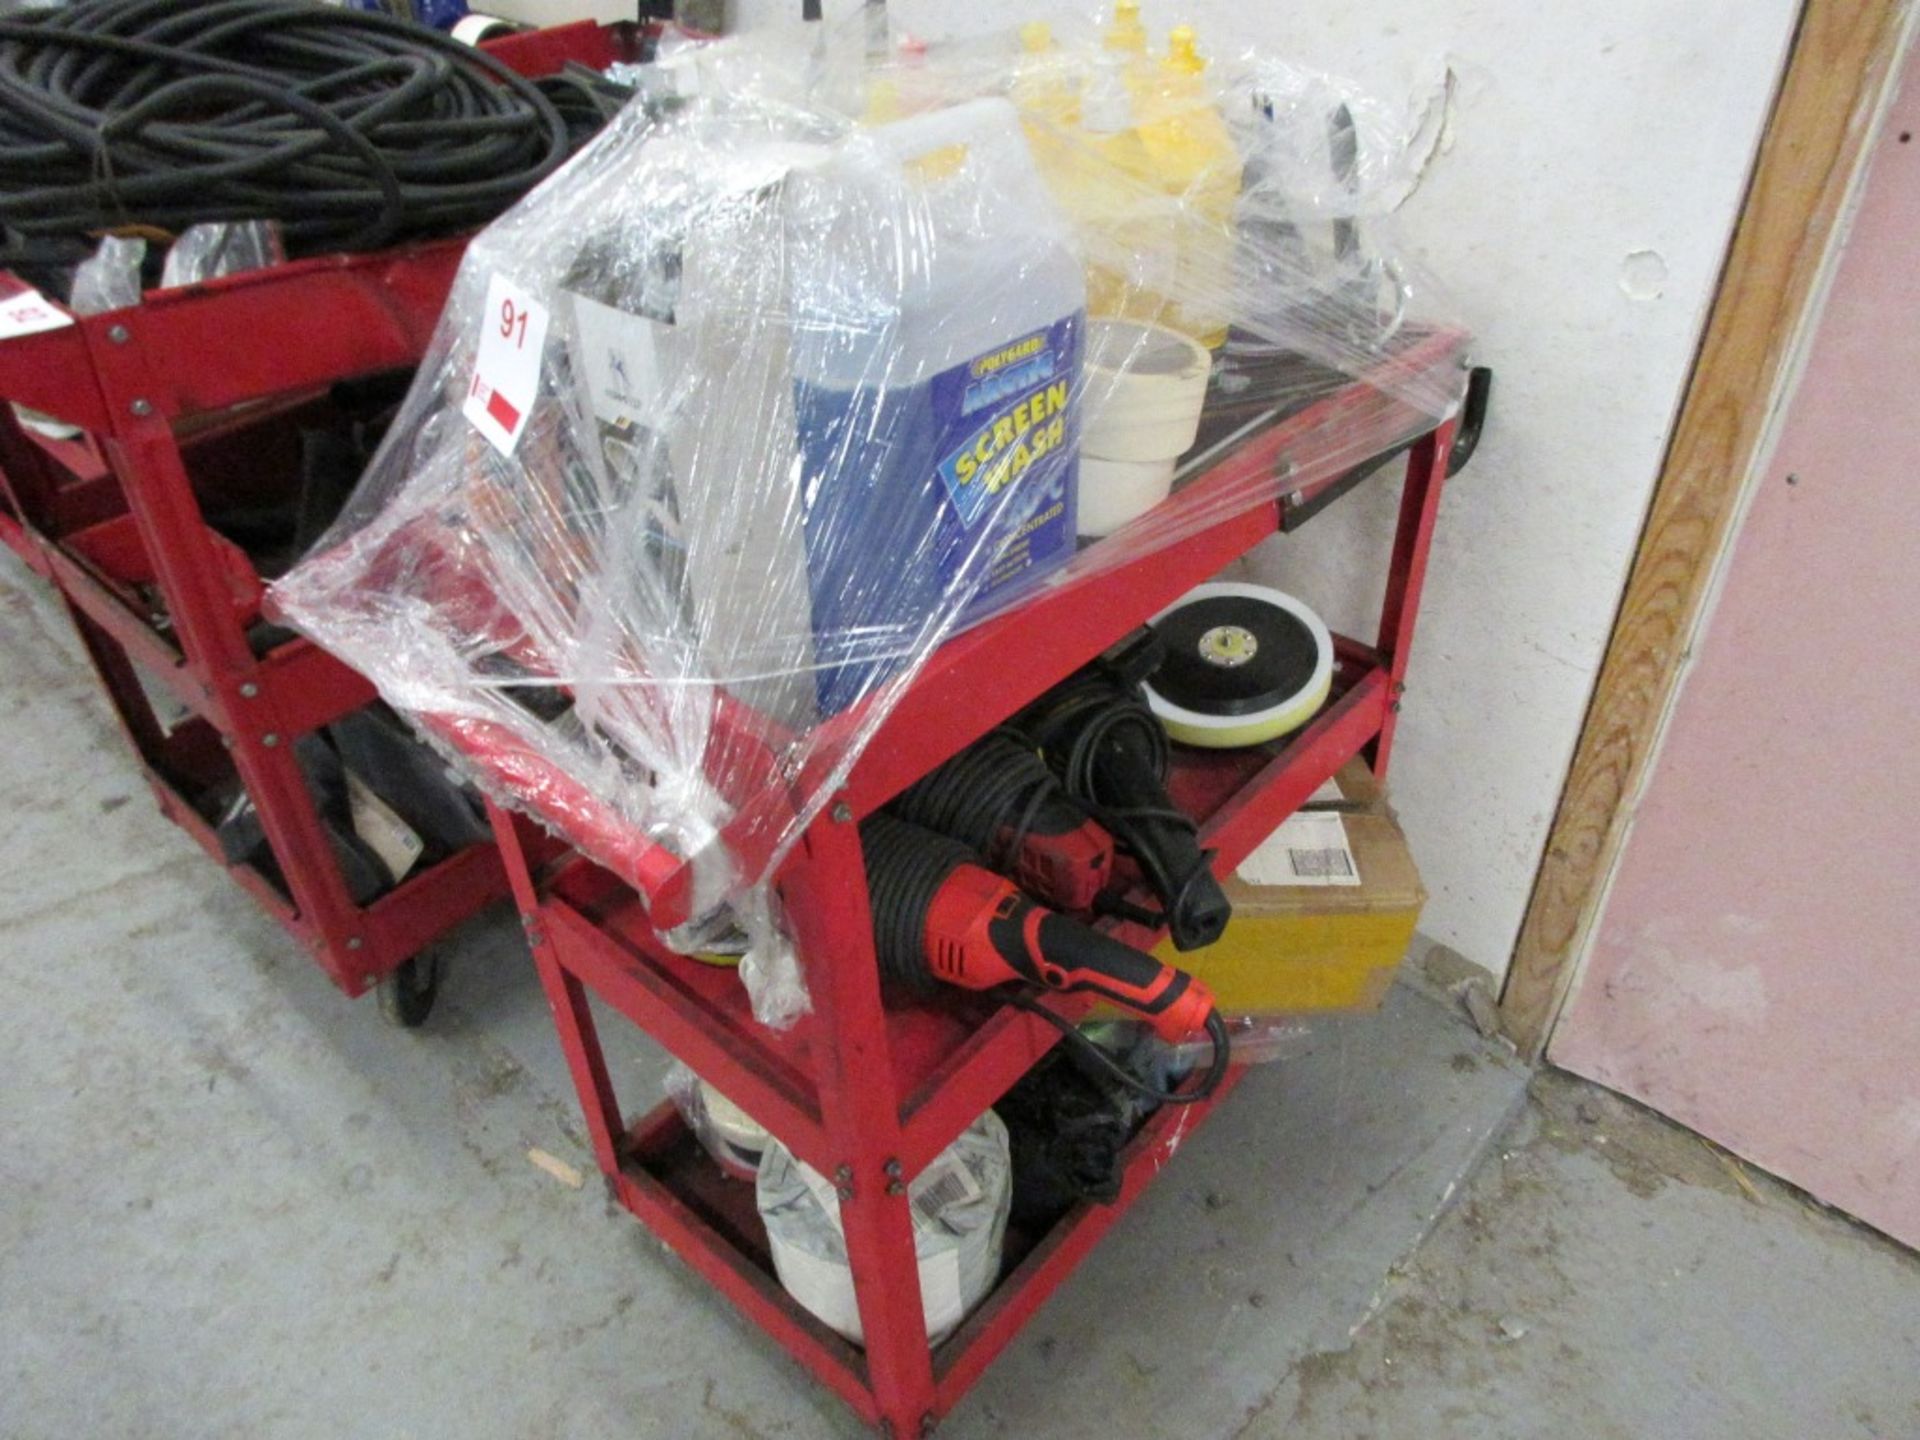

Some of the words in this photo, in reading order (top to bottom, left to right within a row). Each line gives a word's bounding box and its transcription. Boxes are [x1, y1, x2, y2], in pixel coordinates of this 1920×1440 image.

[500, 298, 529, 350] 91
[955, 380, 1068, 485] SCREEN
[983, 421, 1064, 494] WASH
